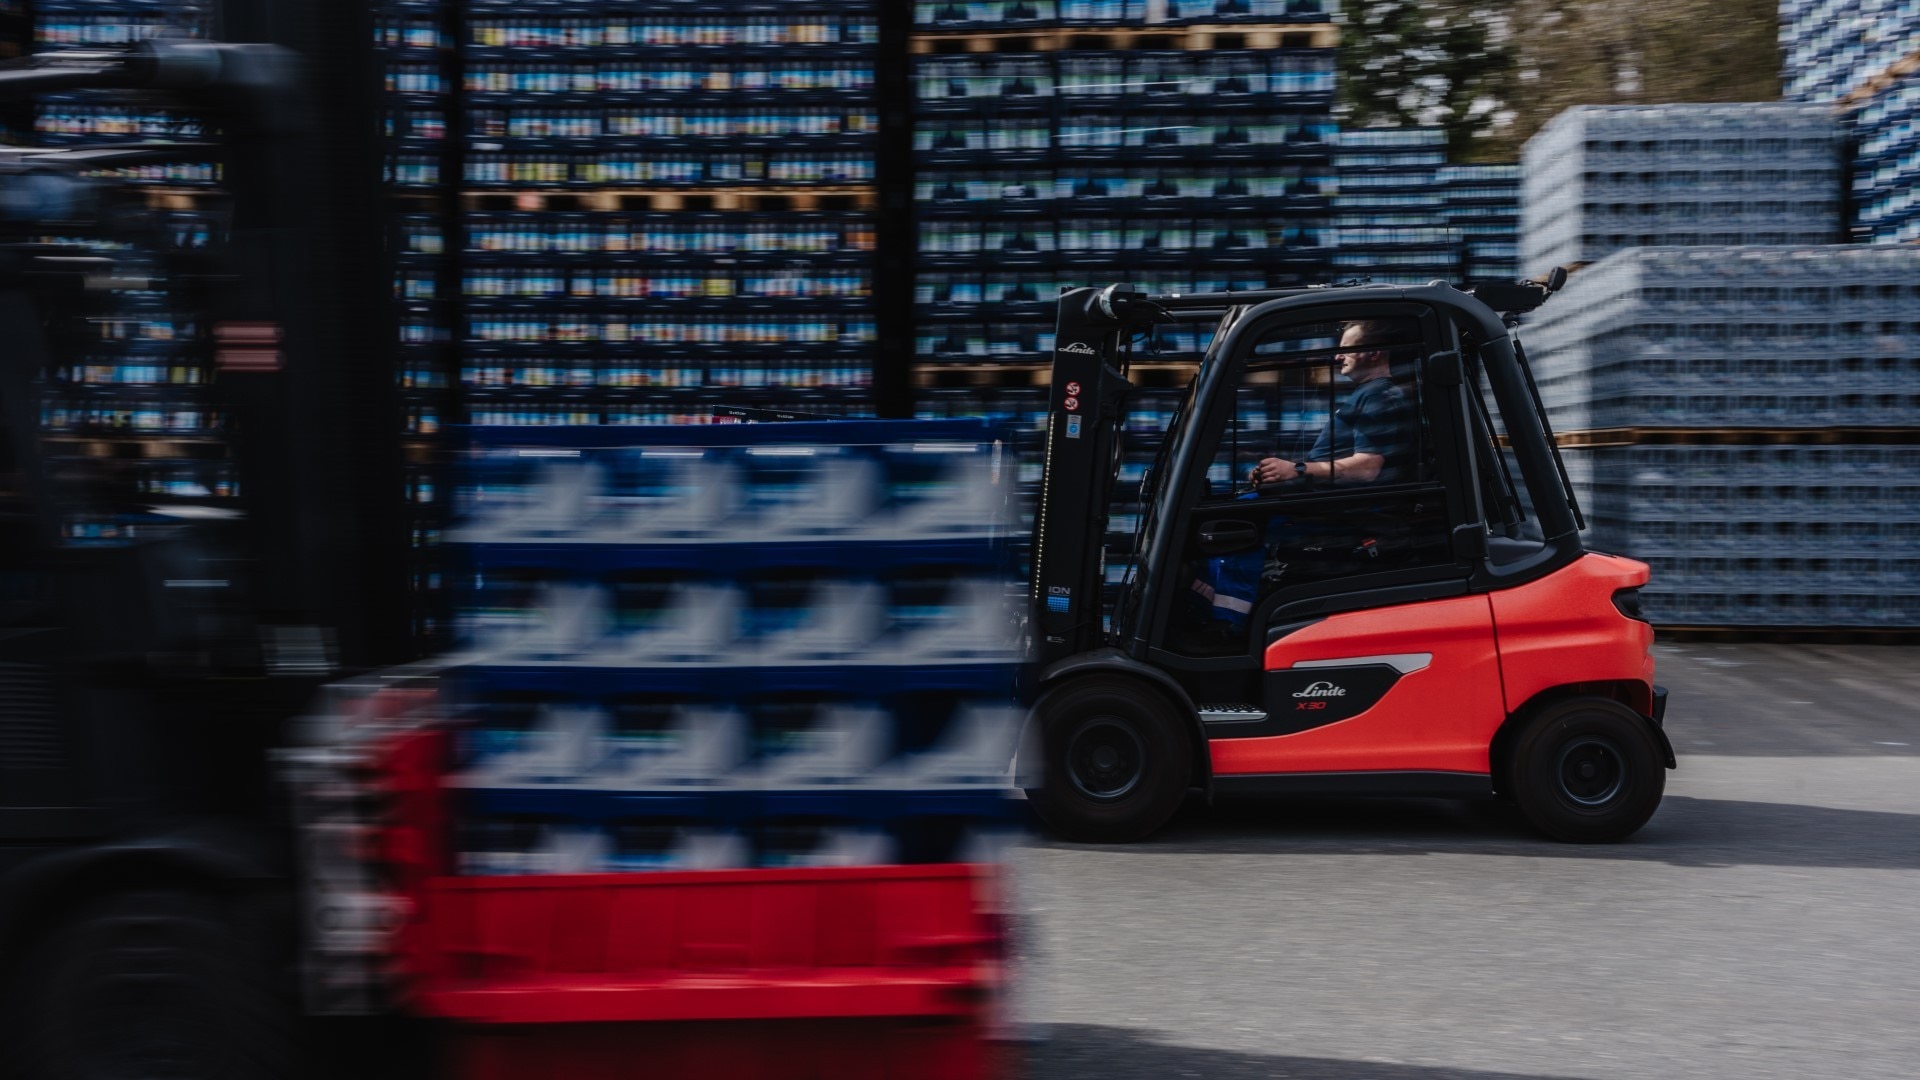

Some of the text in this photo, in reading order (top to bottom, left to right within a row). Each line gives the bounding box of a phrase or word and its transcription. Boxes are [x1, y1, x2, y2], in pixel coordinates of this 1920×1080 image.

[1058, 342, 1096, 355] Linde
[1048, 586, 1071, 595] ION
[1292, 681, 1346, 698] Linde
